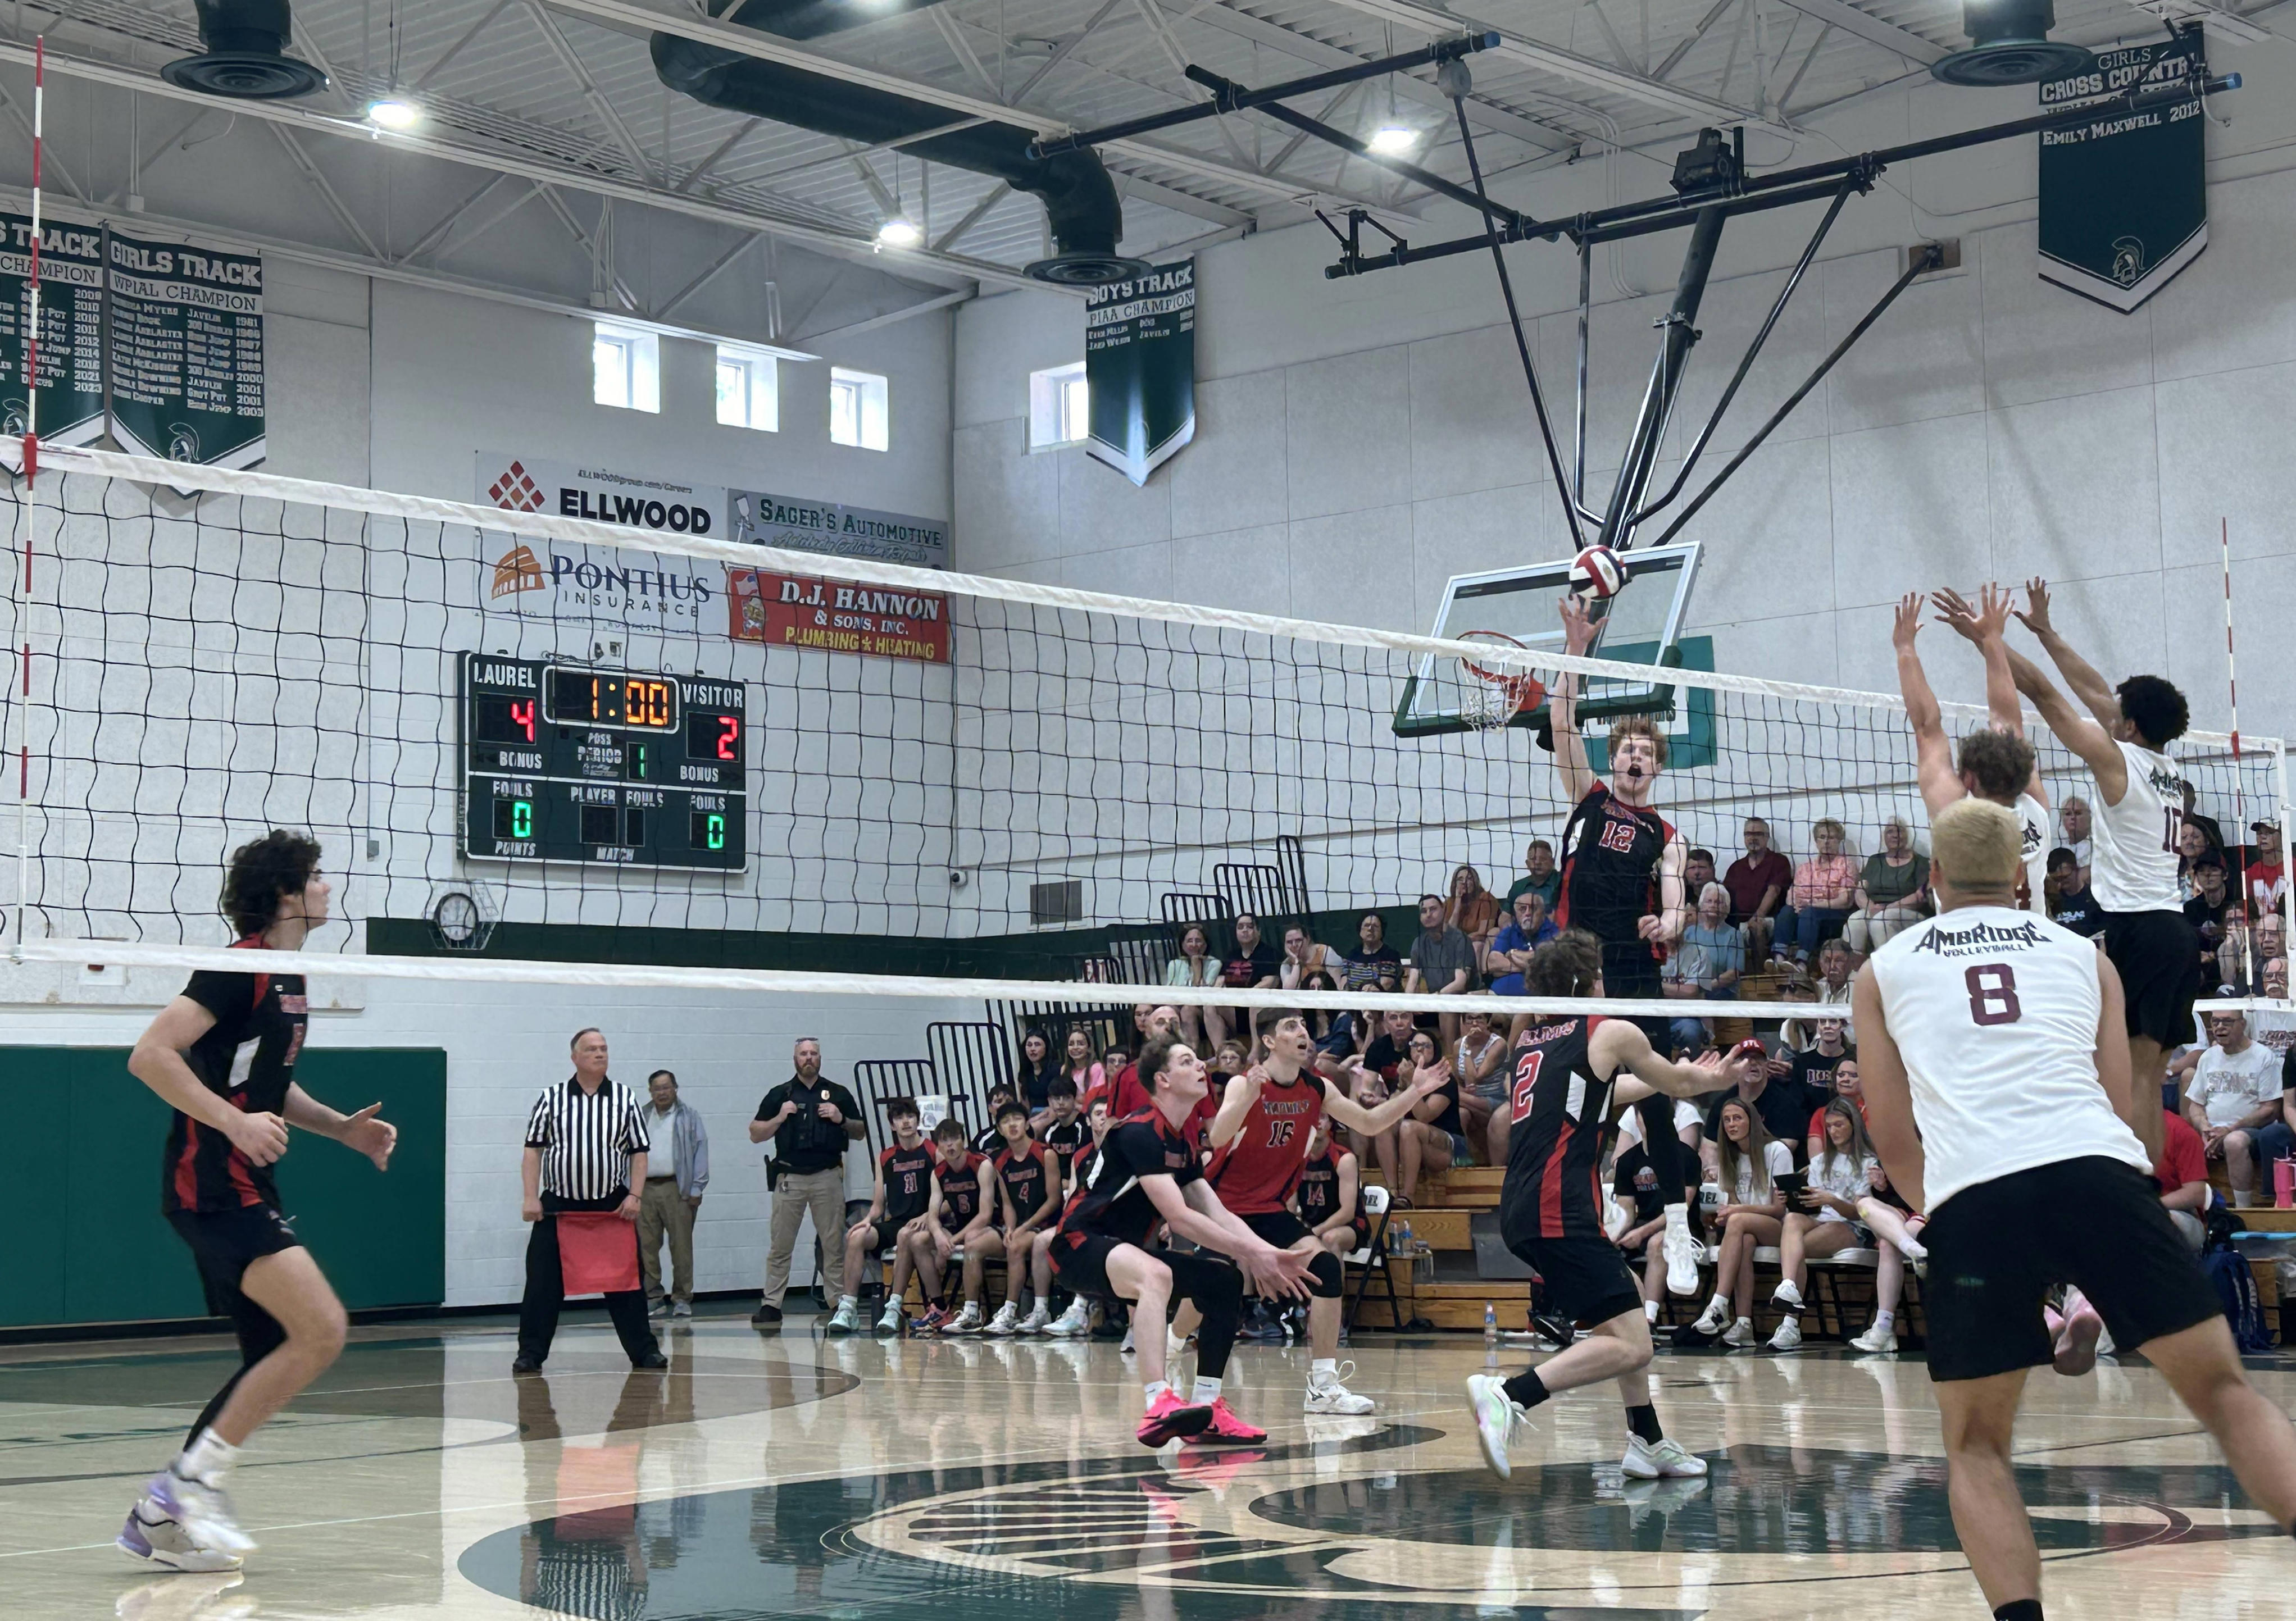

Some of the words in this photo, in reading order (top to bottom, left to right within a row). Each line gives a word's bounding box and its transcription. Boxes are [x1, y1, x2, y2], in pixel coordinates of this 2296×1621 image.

[2098, 48, 2150, 70] GIRLS
[2042, 73, 2103, 102] CROSS
[2109, 53, 2194, 89] COUNTR
[2043, 129, 2088, 145] EMILY
[2091, 113, 2162, 139] MAXWELL
[2170, 101, 2200, 122] 2012
[111, 240, 173, 274] GIRLS
[178, 253, 261, 287] TRACK
[114, 275, 159, 297] WPIAL
[166, 285, 256, 311] CHAMPION
[1136, 265, 1193, 294] TRACK
[1090, 308, 1118, 325] PIAA
[1124, 293, 1193, 317] CHAMPION
[75, 324, 98, 335] 2011
[75, 335, 100, 347] 2012
[75, 347, 100, 358] 2014
[75, 370, 100, 381] 2021
[236, 383, 261, 395] 2001
[560, 488, 711, 534] ELLWOOD
[760, 498, 836, 530] SAGER'S
[843, 514, 942, 546] AUTOMOTIVE
[551, 554, 710, 603] PONTIUS
[564, 590, 698, 617] INSURANCE
[780, 581, 825, 607] D.J.
[834, 588, 939, 621] HANNON
[814, 609, 828, 626] &
[881, 620, 909, 635] INC.
[785, 626, 859, 651] PLUMBING
[876, 639, 935, 660] HEATING
[474, 662, 537, 688] LAUREL
[593, 677, 668, 726] 1:00
[682, 683, 743, 708] VISITOR
[511, 699, 534, 743] 4
[718, 716, 738, 759] 2
[499, 751, 543, 769] BONUS
[578, 746, 622, 764] PERIOD
[639, 746, 645, 777] 1
[680, 764, 719, 782] BONUS
[493, 780, 533, 797] FOULS
[571, 786, 616, 804] PLAYER
[626, 790, 664, 808] FOULS
[690, 795, 726, 812] FOULS
[513, 802, 531, 837] 0
[708, 814, 724, 849] 0
[495, 841, 536, 857] POINTS
[1598, 820, 1636, 853] 12
[596, 846, 635, 862] MATCH
[1911, 919, 2053, 955] AMBRIDGE
[1965, 963, 2022, 1027] 8
[1511, 1050, 1544, 1125] 2
[1266, 1121, 1295, 1148] 16
[1307, 1182, 1326, 1206] 14
